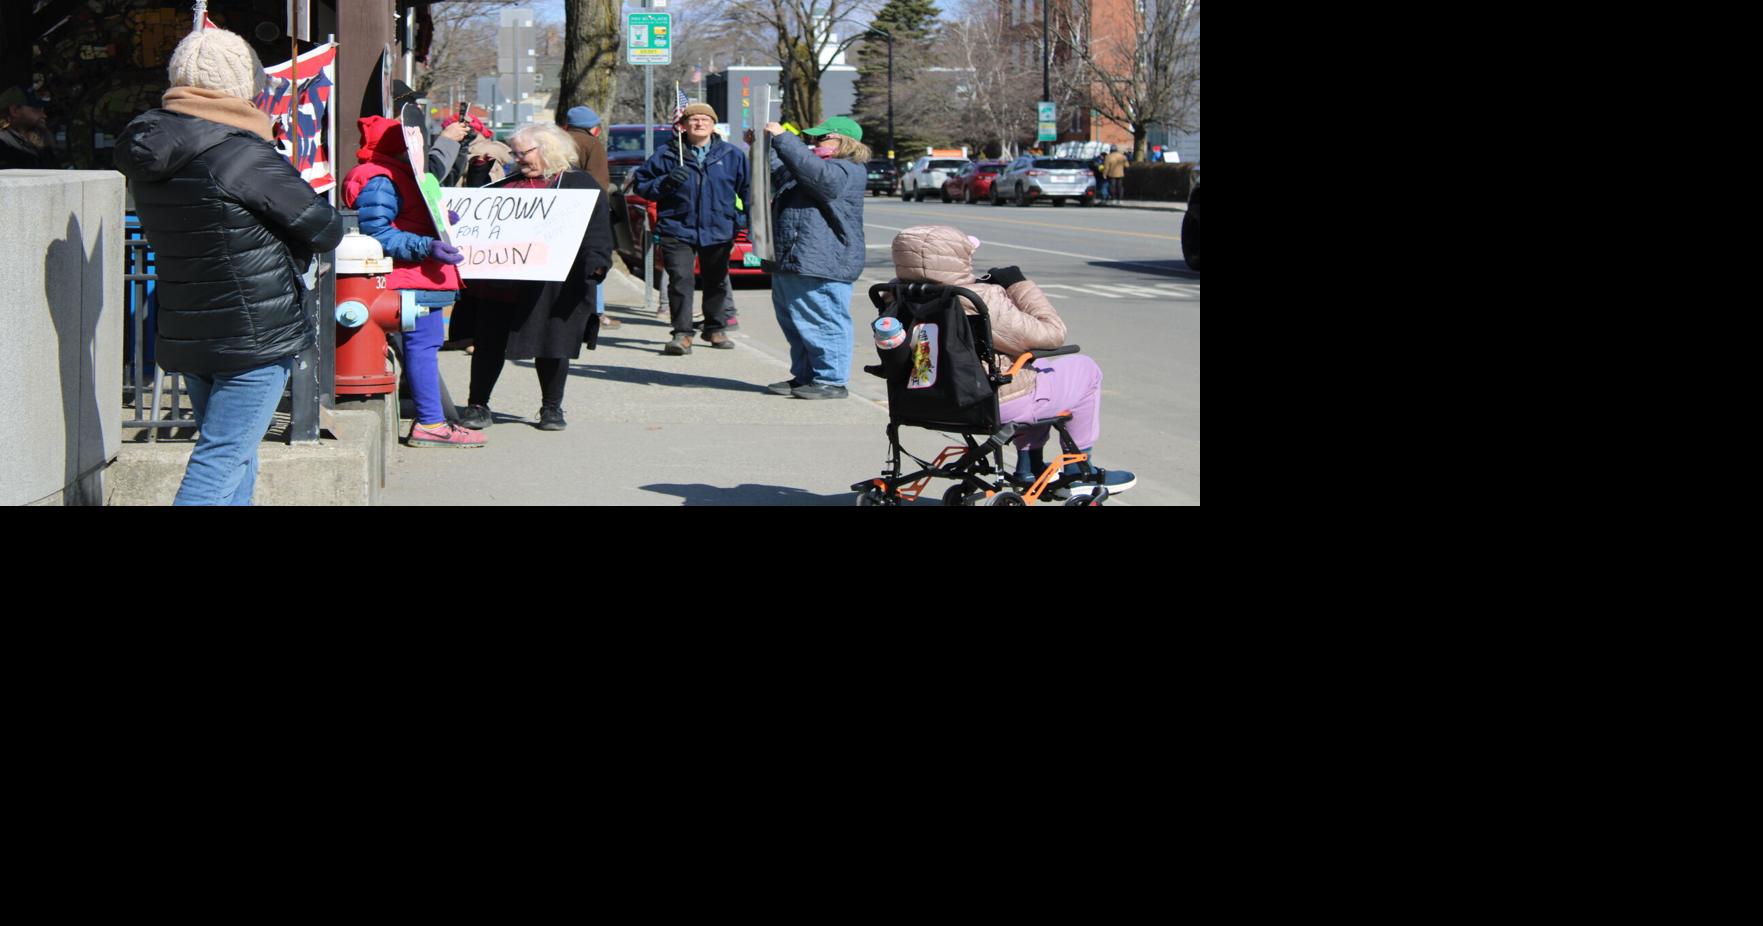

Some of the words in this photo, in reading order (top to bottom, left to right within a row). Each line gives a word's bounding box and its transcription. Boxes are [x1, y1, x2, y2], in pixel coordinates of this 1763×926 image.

[446, 197, 471, 219] NO
[474, 195, 556, 226] CROWN
[456, 225, 480, 239] FOR
[488, 225, 501, 239] A
